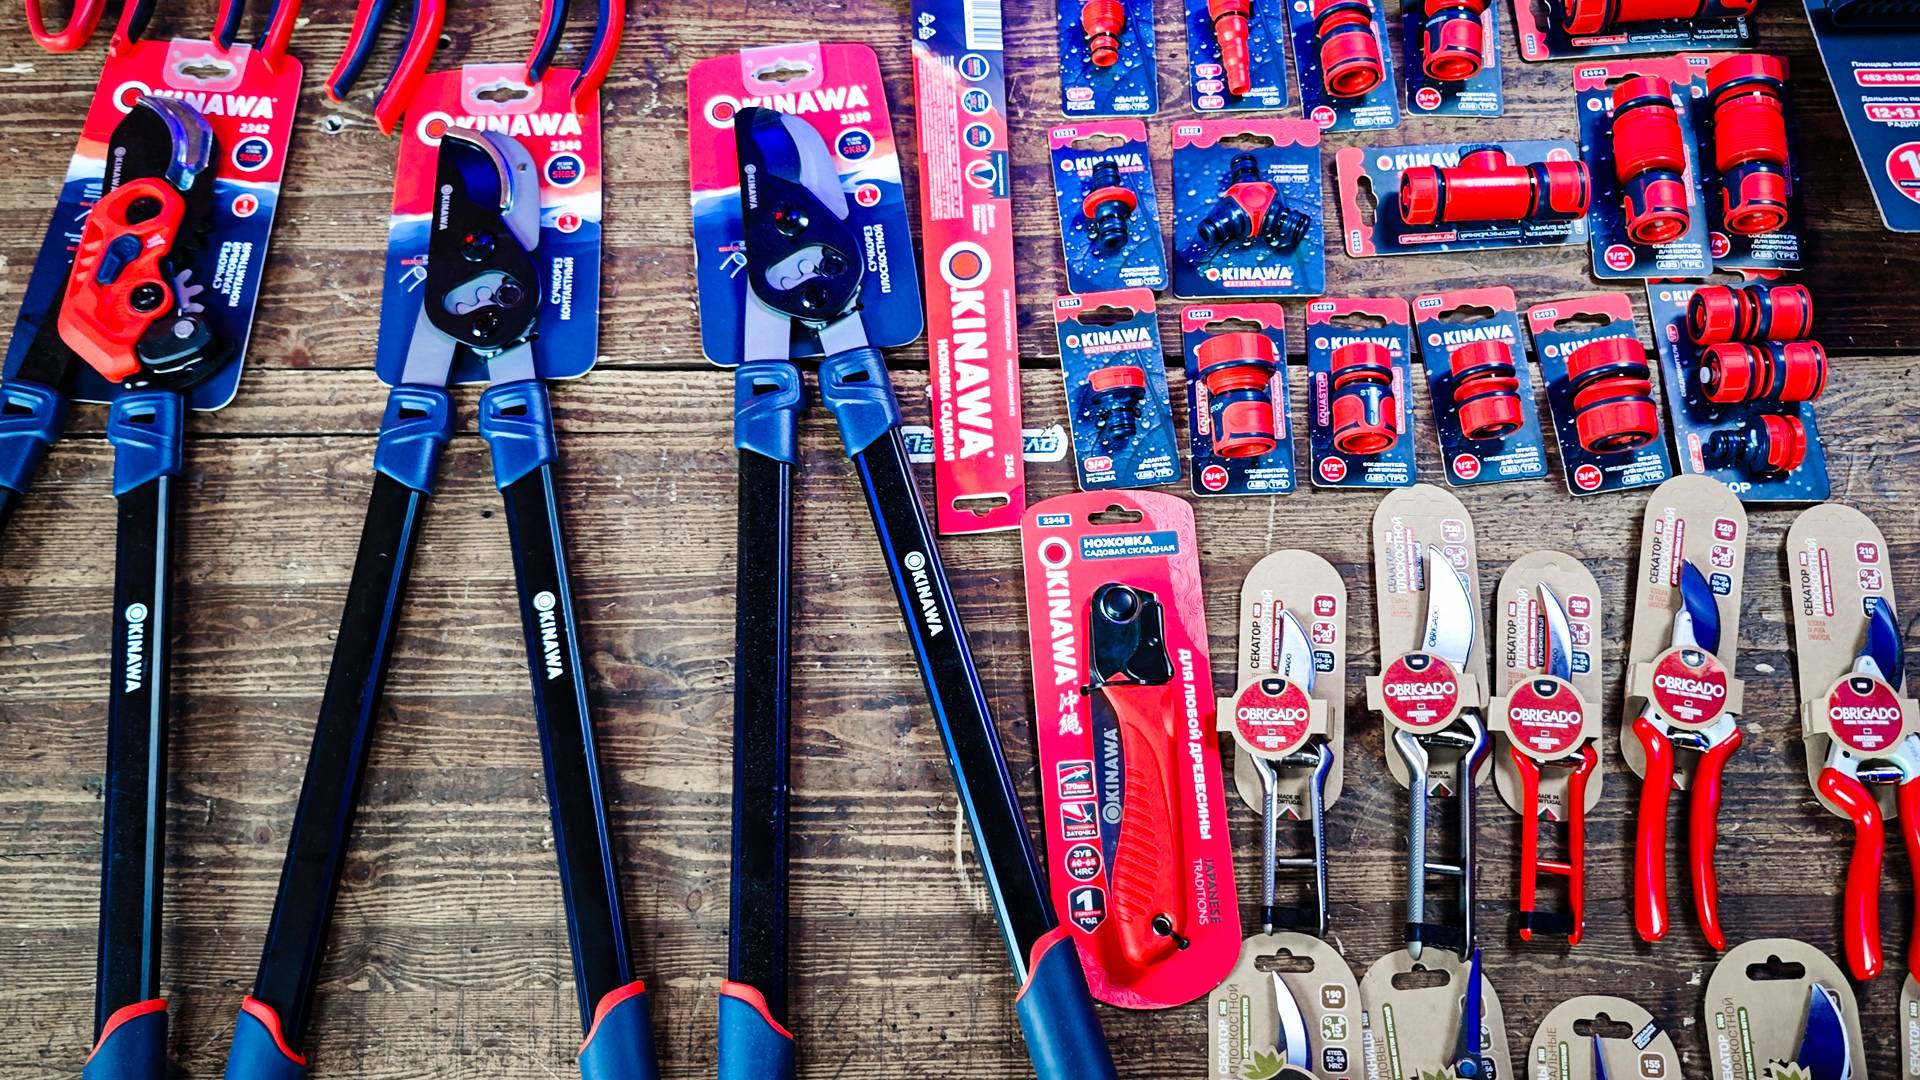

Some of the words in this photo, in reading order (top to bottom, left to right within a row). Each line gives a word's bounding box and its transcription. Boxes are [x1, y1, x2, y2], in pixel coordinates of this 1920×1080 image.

[239, 122, 270, 134] 2342
[840, 111, 872, 125] 2350
[1872, 107, 1915, 118] 12-13
[744, 163, 758, 210] OKINAWA
[438, 184, 453, 231] OKINAWA
[212, 241, 233, 289] СУЧКОРЕЗ
[221, 241, 243, 294] ХРАПОВЫЙ
[863, 225, 878, 272] СУЧКОРЕЗ
[874, 223, 892, 293] ПЛОСКОСТНОЙ
[1608, 252, 1629, 261] 1/2"
[228, 241, 254, 307] КОНТАКТНЫЙ
[551, 257, 564, 305] СУЧКОРЕЗ
[560, 257, 574, 320] КОНТАКТНЫЙ
[1206, 267, 1292, 282] OKINAWA
[939, 241, 995, 460] OKINAWA
[1066, 327, 1151, 349] OKINAWA
[1428, 325, 1514, 346] OKINAWA
[937, 338, 950, 400] НОЖОВКА
[1673, 344, 1686, 397] СОЕДИНИТЕЛИ
[1197, 382, 1209, 434] AQUASTOP
[1318, 373, 1328, 425] AQUASTOP
[940, 401, 956, 461] САДОВАЯ
[1004, 453, 1015, 479] 2345
[1086, 460, 1110, 470] 3/4"
[1205, 472, 1225, 481] 3/4"
[1323, 463, 1343, 472] 1/2"
[1456, 460, 1476, 469] 1/2"
[1577, 472, 1599, 481] 3/4"
[1084, 535, 1153, 549] НОЖОВКА
[1659, 507, 1676, 586] ПЛОСКОСТНОЙ
[1717, 523, 1733, 532] 220
[1085, 548, 1126, 557] САДОВАЯ
[1127, 545, 1175, 556] СКЛАДНАЯ
[1394, 516, 1404, 594] ПЛОСКОСТНОЙ
[1649, 537, 1662, 584] СЕКАТОР
[1859, 547, 1874, 555] 210
[903, 551, 944, 637] OKINAWA
[1804, 569, 1813, 617] СЕКАТОР
[1807, 537, 1817, 617] ПЛОСКОСТНОЙ
[1867, 576, 1878, 584] 20
[1038, 537, 1077, 686] OKINAWA
[1317, 600, 1333, 608] 180
[1571, 600, 1587, 609] 200
[125, 602, 148, 693] OKINAWA
[533, 590, 563, 680] OKINAWA
[1250, 621, 1261, 669] СЕКАТОР
[1261, 589, 1273, 671] ПЛОСКОСТНОЙ
[1321, 630, 1332, 638] 20
[1507, 620, 1517, 668] СЕКАТОР
[1517, 588, 1529, 670] ПЛОСКОСТНОЙ
[1576, 631, 1586, 639] 15
[1178, 648, 1193, 681] ДЛЯ
[1384, 682, 1455, 699] OBRIGADO
[1655, 674, 1725, 698] OBRIGADO
[1183, 682, 1203, 739] ЛЮБОЙ
[1237, 707, 1308, 721] OBRIGADO
[1510, 707, 1580, 724] OBRIGADO
[1830, 706, 1900, 721] OBRIGADO
[1102, 727, 1122, 825] OKINAWA
[1188, 740, 1212, 840] ДРЕВЕСИНЫ
[1066, 829, 1096, 837] ЗАТОЧКА
[1071, 858, 1096, 867] 60-65
[1073, 849, 1092, 858] ЗУБ
[1075, 867, 1094, 876] HRC
[1076, 890, 1093, 911] 1
[1192, 858, 1209, 926] TRADITIONS
[1205, 858, 1222, 924] JAPANESE
[1080, 917, 1098, 925] ГОД
[1325, 990, 1341, 999] 190
[1218, 1020, 1228, 1074] СЕКАТОР
[1229, 984, 1239, 1074] ПЛОСКОСТНОЙ
[1910, 1021, 1920, 1076] СЕКАТОР
[1644, 1060, 1661, 1068] 155
